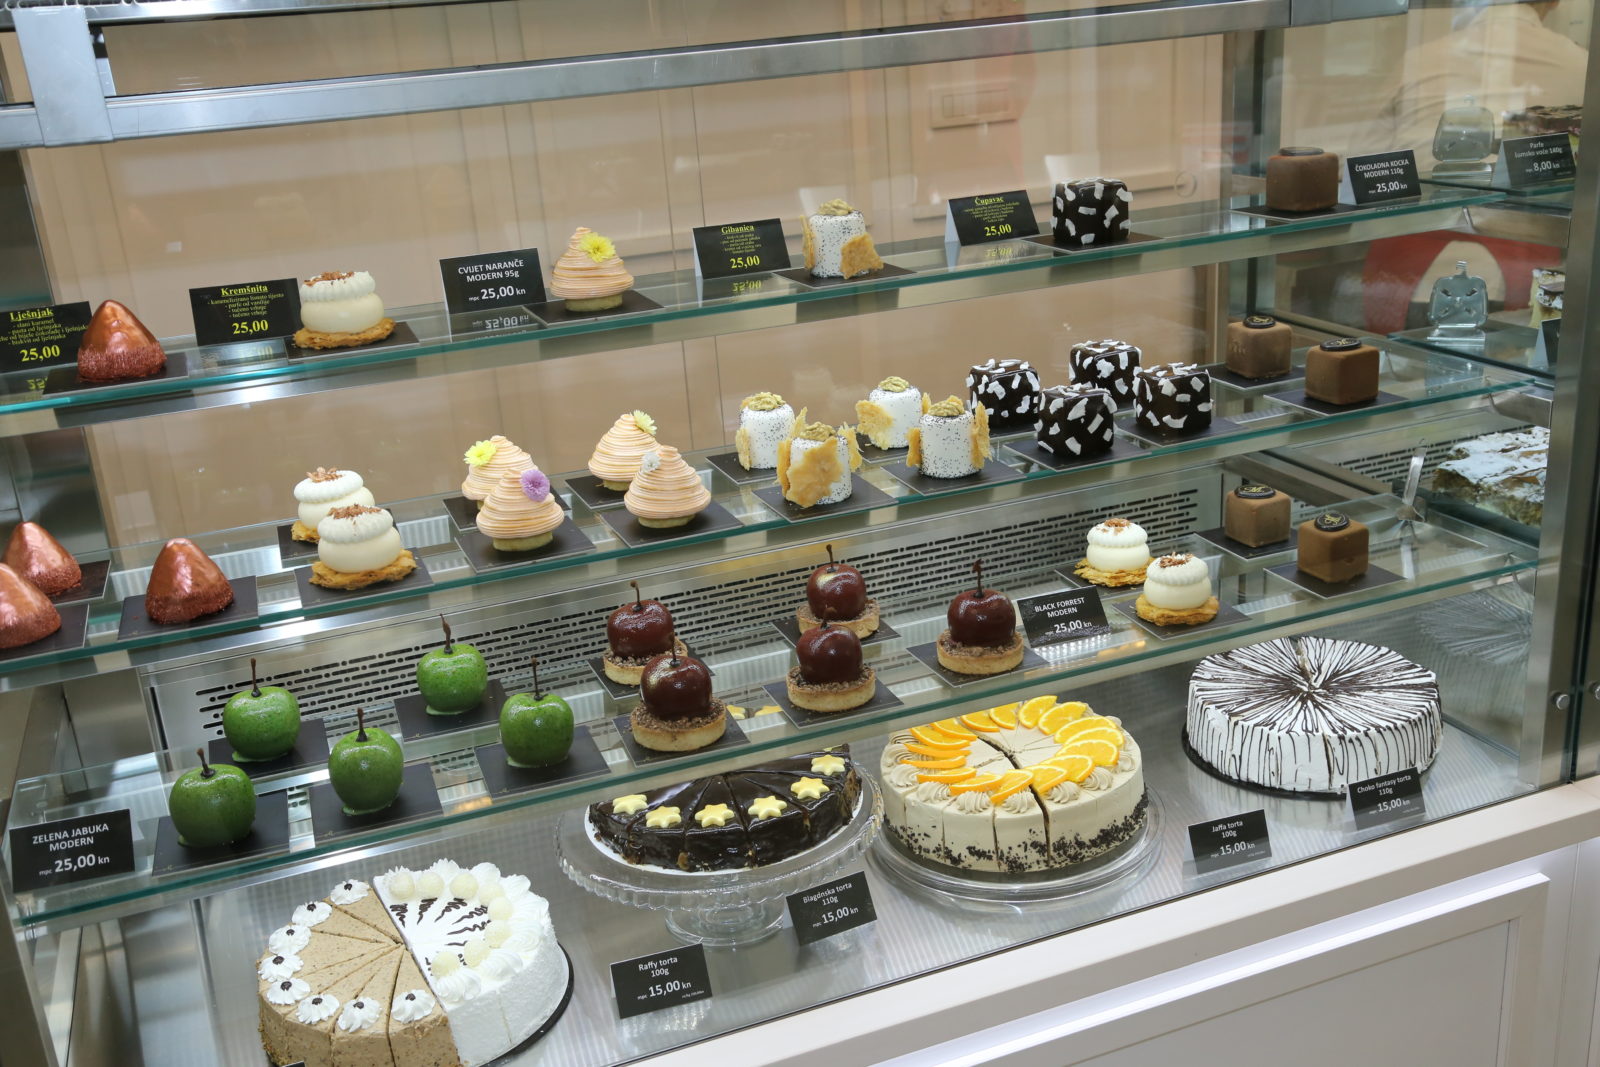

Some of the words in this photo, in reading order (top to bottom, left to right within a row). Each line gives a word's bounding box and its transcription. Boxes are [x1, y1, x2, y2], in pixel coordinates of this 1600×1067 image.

[1355, 161, 1390, 172] ČOKOLADNA
[1363, 169, 1389, 178] MODERN
[1533, 161, 1552, 172] 8,00
[1376, 181, 1400, 193] 25,00
[721, 224, 755, 235] Gibanica
[984, 223, 1012, 237] 25,00
[457, 264, 484, 275] CVIJET
[485, 258, 525, 271] NARANČE
[729, 255, 760, 269] 25,00
[466, 272, 504, 282] MODERN
[504, 270, 520, 278] 95g
[221, 284, 269, 297] Kremšnita
[480, 285, 514, 300] 25,00
[9, 307, 54, 321] Lješnjak
[231, 319, 269, 334] 25,00
[20, 344, 61, 362] 25,00
[1034, 602, 1056, 613] BLACK
[1056, 597, 1085, 608] FORREST
[1046, 606, 1078, 618] MODERN
[1053, 619, 1083, 634] 25,00
[1357, 783, 1376, 794] Choko
[1375, 779, 1397, 790] fantasy
[1396, 775, 1412, 783] torta
[1378, 787, 1393, 796] 110g
[1377, 798, 1402, 812] 15,00
[1211, 823, 1227, 833] Jaffa
[1227, 820, 1244, 829] torta
[32, 830, 70, 845] ZELENA
[70, 823, 109, 837] JABUKA
[1221, 830, 1238, 839] 100g
[49, 836, 94, 852] MODERN
[1219, 841, 1246, 856] 15,00
[38, 868, 52, 876] mpc
[54, 854, 96, 873] 25,00
[97, 855, 110, 864] kn
[835, 882, 853, 892] torta
[822, 896, 840, 906] 110g
[821, 906, 850, 924] 15,00
[638, 961, 658, 971] Raffy
[658, 957, 678, 967] torta
[650, 968, 670, 977] 100g
[648, 980, 681, 997] 15,00
[681, 981, 692, 989] kn
